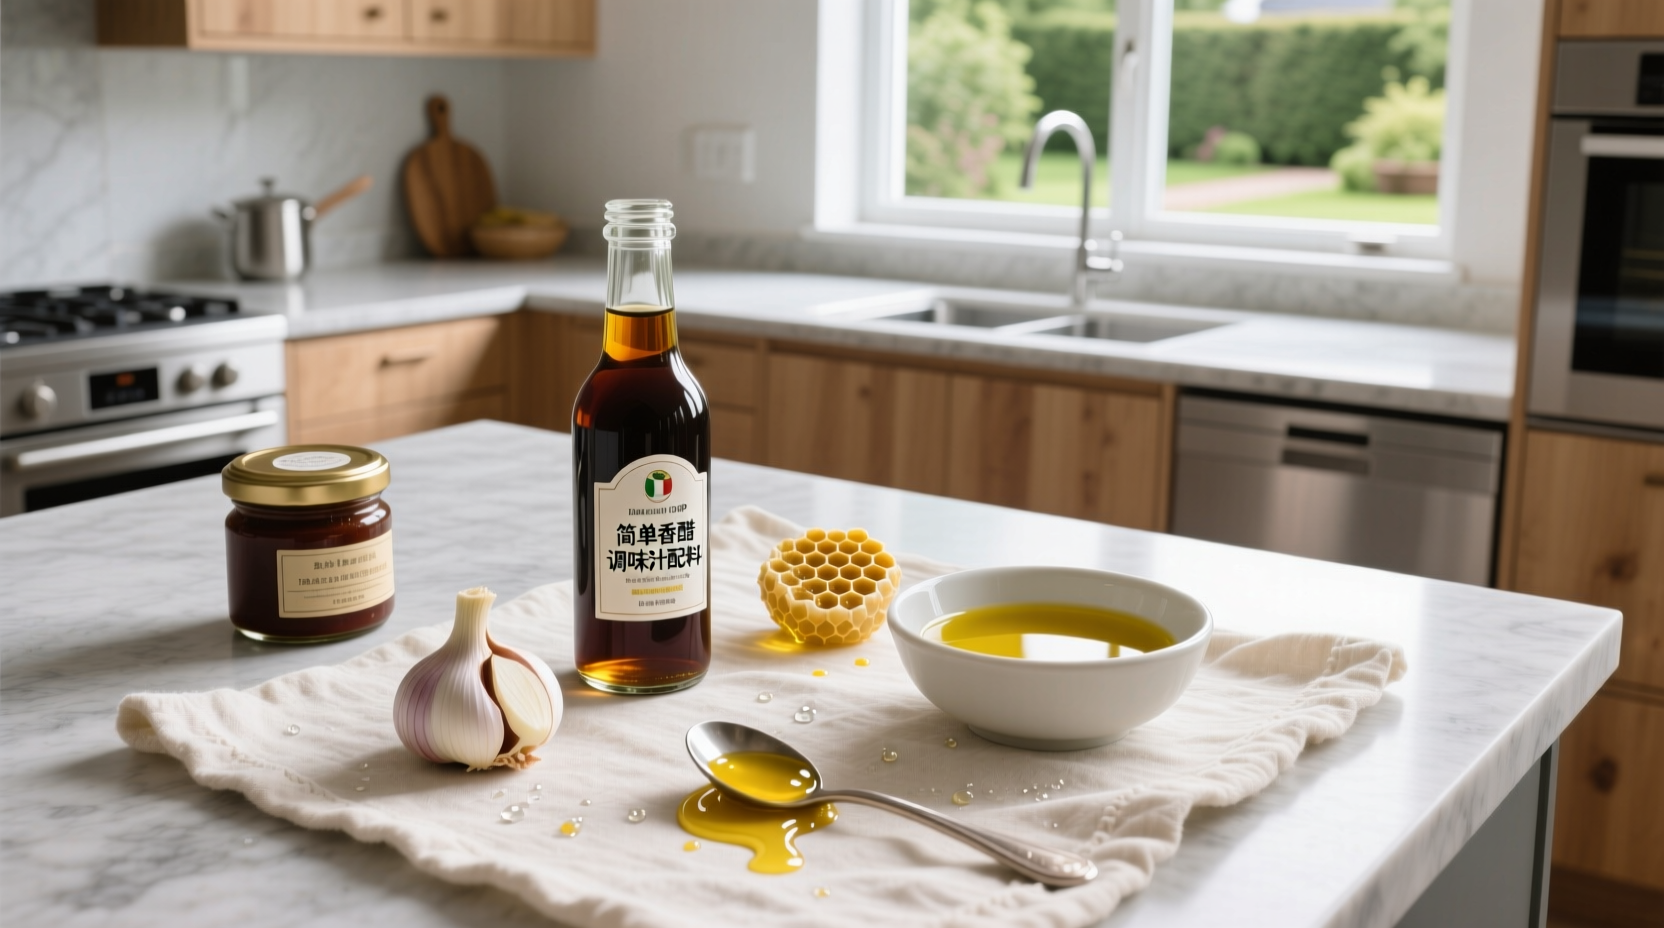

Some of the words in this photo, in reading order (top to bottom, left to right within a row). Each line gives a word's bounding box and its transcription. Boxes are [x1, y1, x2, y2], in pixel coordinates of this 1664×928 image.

[616, 518, 696, 547] 简单香醋
[606, 544, 702, 573] 调味汁配料
